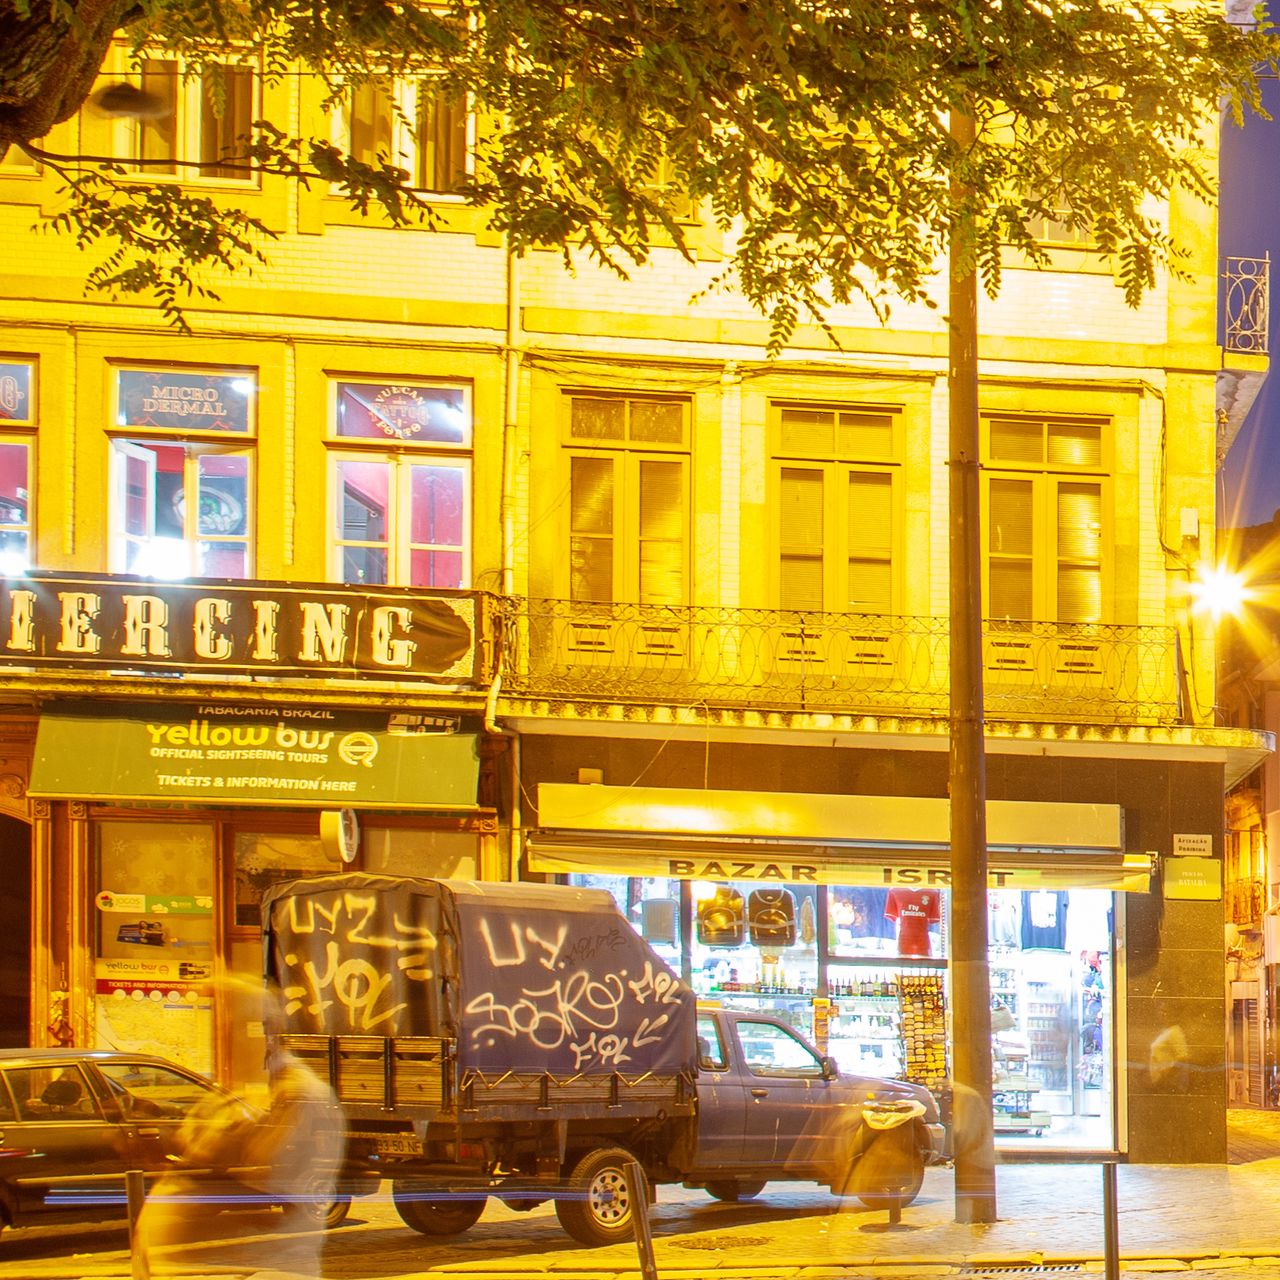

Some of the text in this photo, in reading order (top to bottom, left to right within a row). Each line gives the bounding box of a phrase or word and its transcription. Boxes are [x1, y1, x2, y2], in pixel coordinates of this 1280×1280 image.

[152, 386, 218, 402] MICRO
[143, 399, 227, 416] DERMAL
[276, 722, 334, 750] bus
[151, 747, 328, 764] OFFICIAL SIGHTSEEING TOURS
[157, 775, 357, 792] TICKETS & INFORMATION HERE
[669, 859, 818, 881] BAZAR
